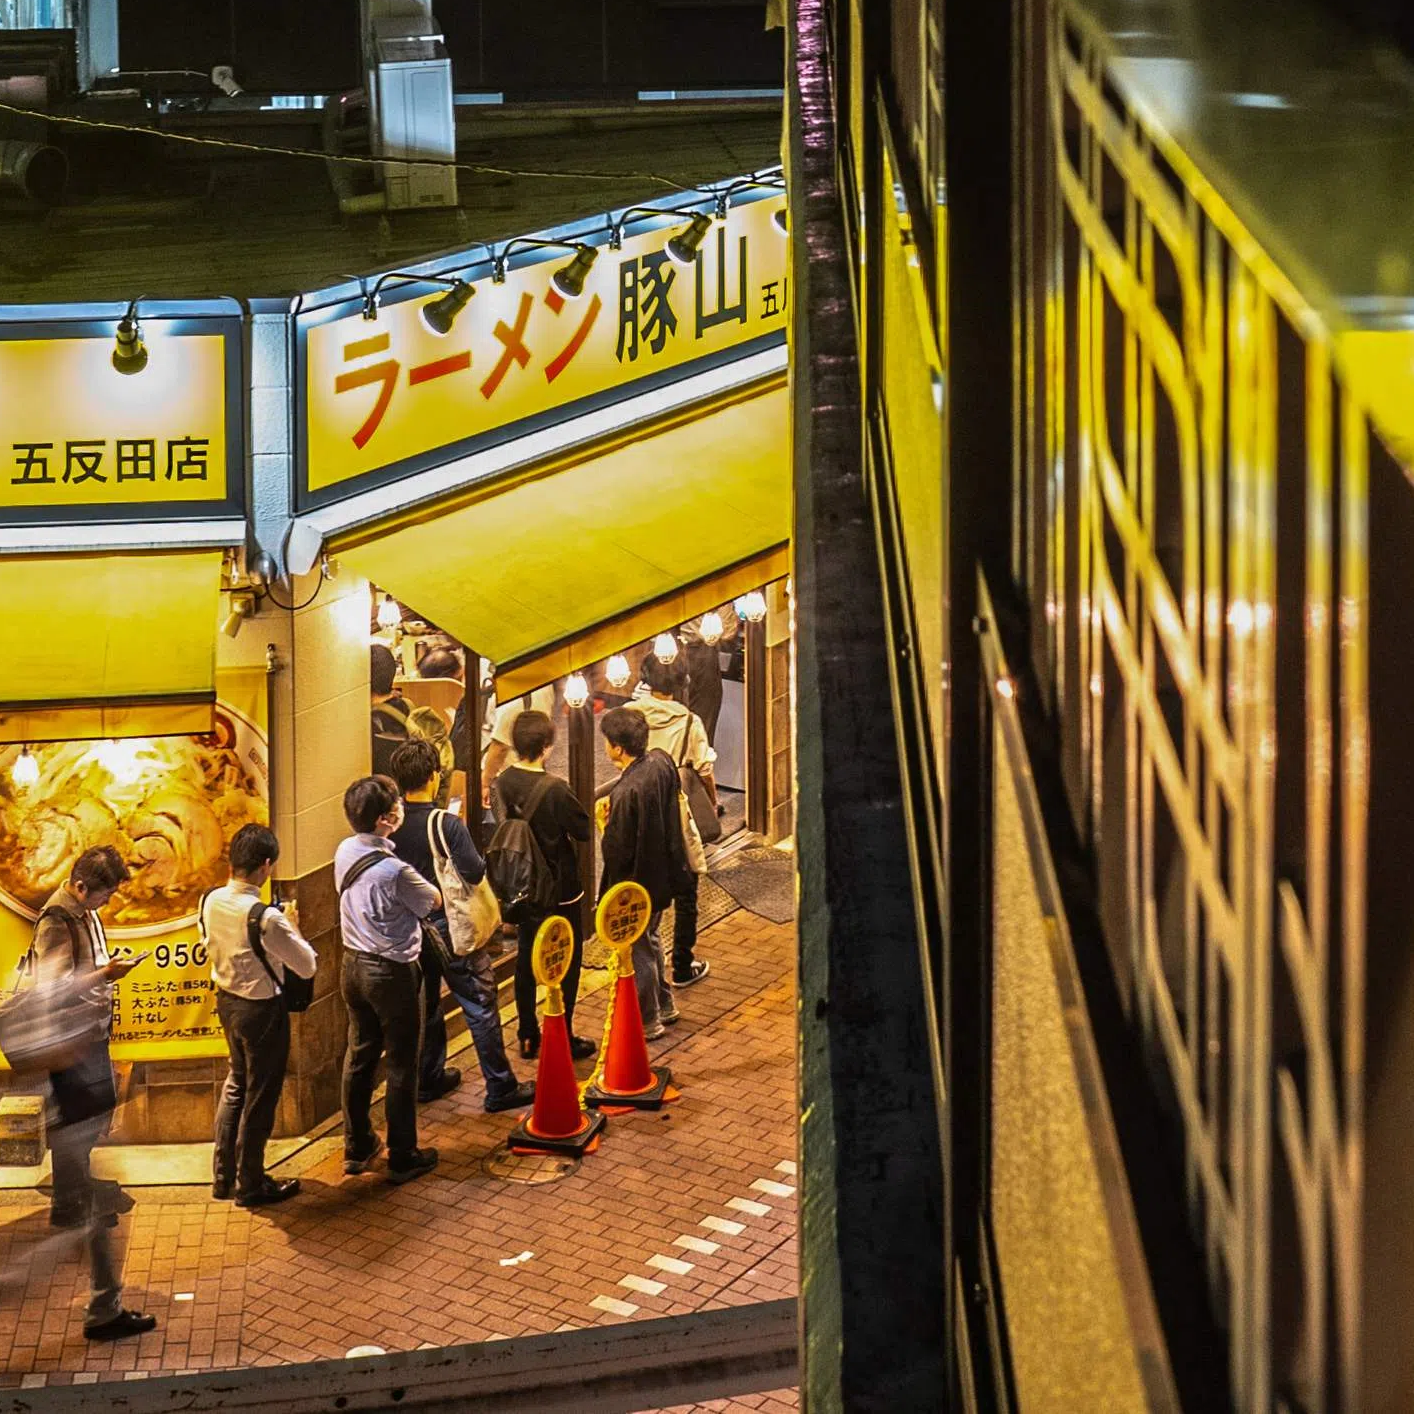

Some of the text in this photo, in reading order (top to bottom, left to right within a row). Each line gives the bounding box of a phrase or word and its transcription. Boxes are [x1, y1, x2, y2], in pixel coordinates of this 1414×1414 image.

[335, 227, 748, 450] ラーメン豚山
[10, 436, 209, 486] 五反田店
[132, 1011, 167, 1025] 汁なし
